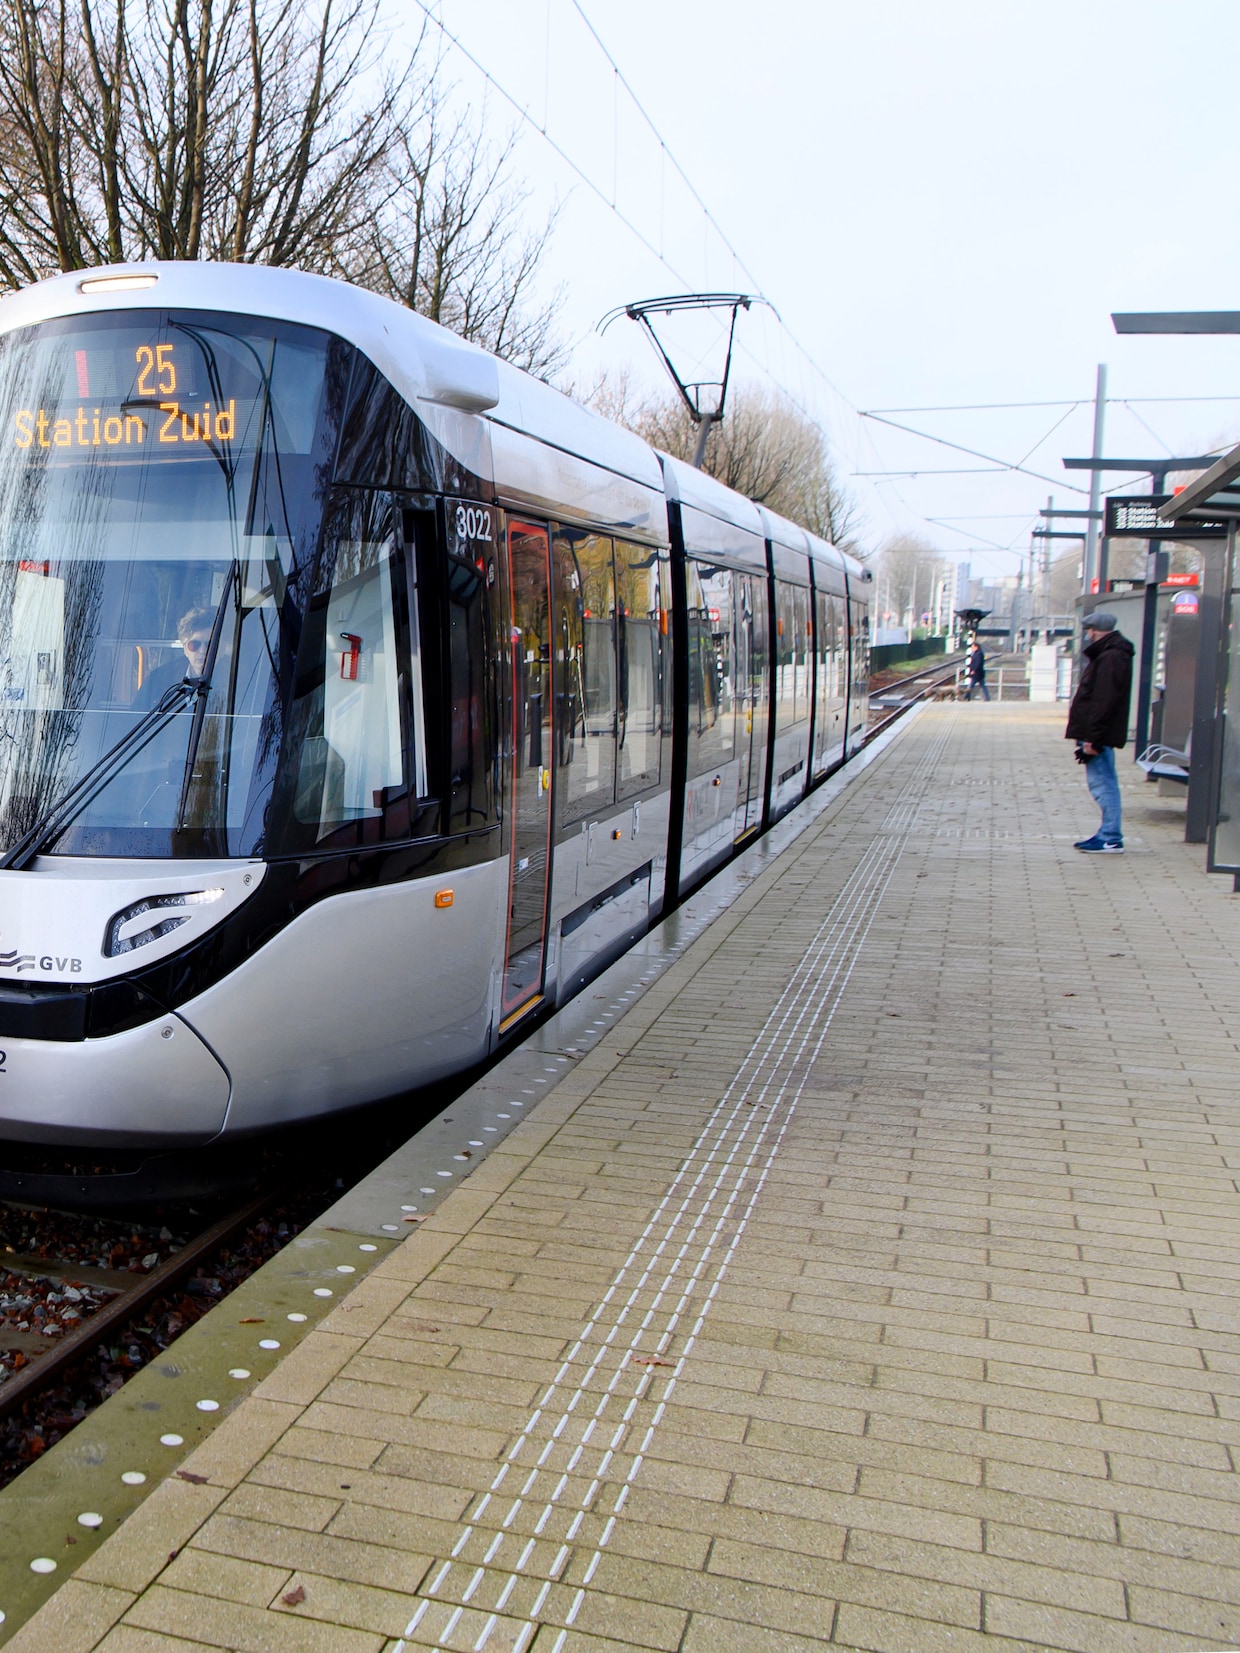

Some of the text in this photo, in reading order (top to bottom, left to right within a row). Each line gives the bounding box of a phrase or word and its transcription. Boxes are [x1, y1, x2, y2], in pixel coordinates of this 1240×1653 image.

[135, 343, 176, 396] 25
[15, 399, 235, 448] Station Zuid
[456, 505, 492, 542] 3022
[39, 956, 82, 973] GVB
